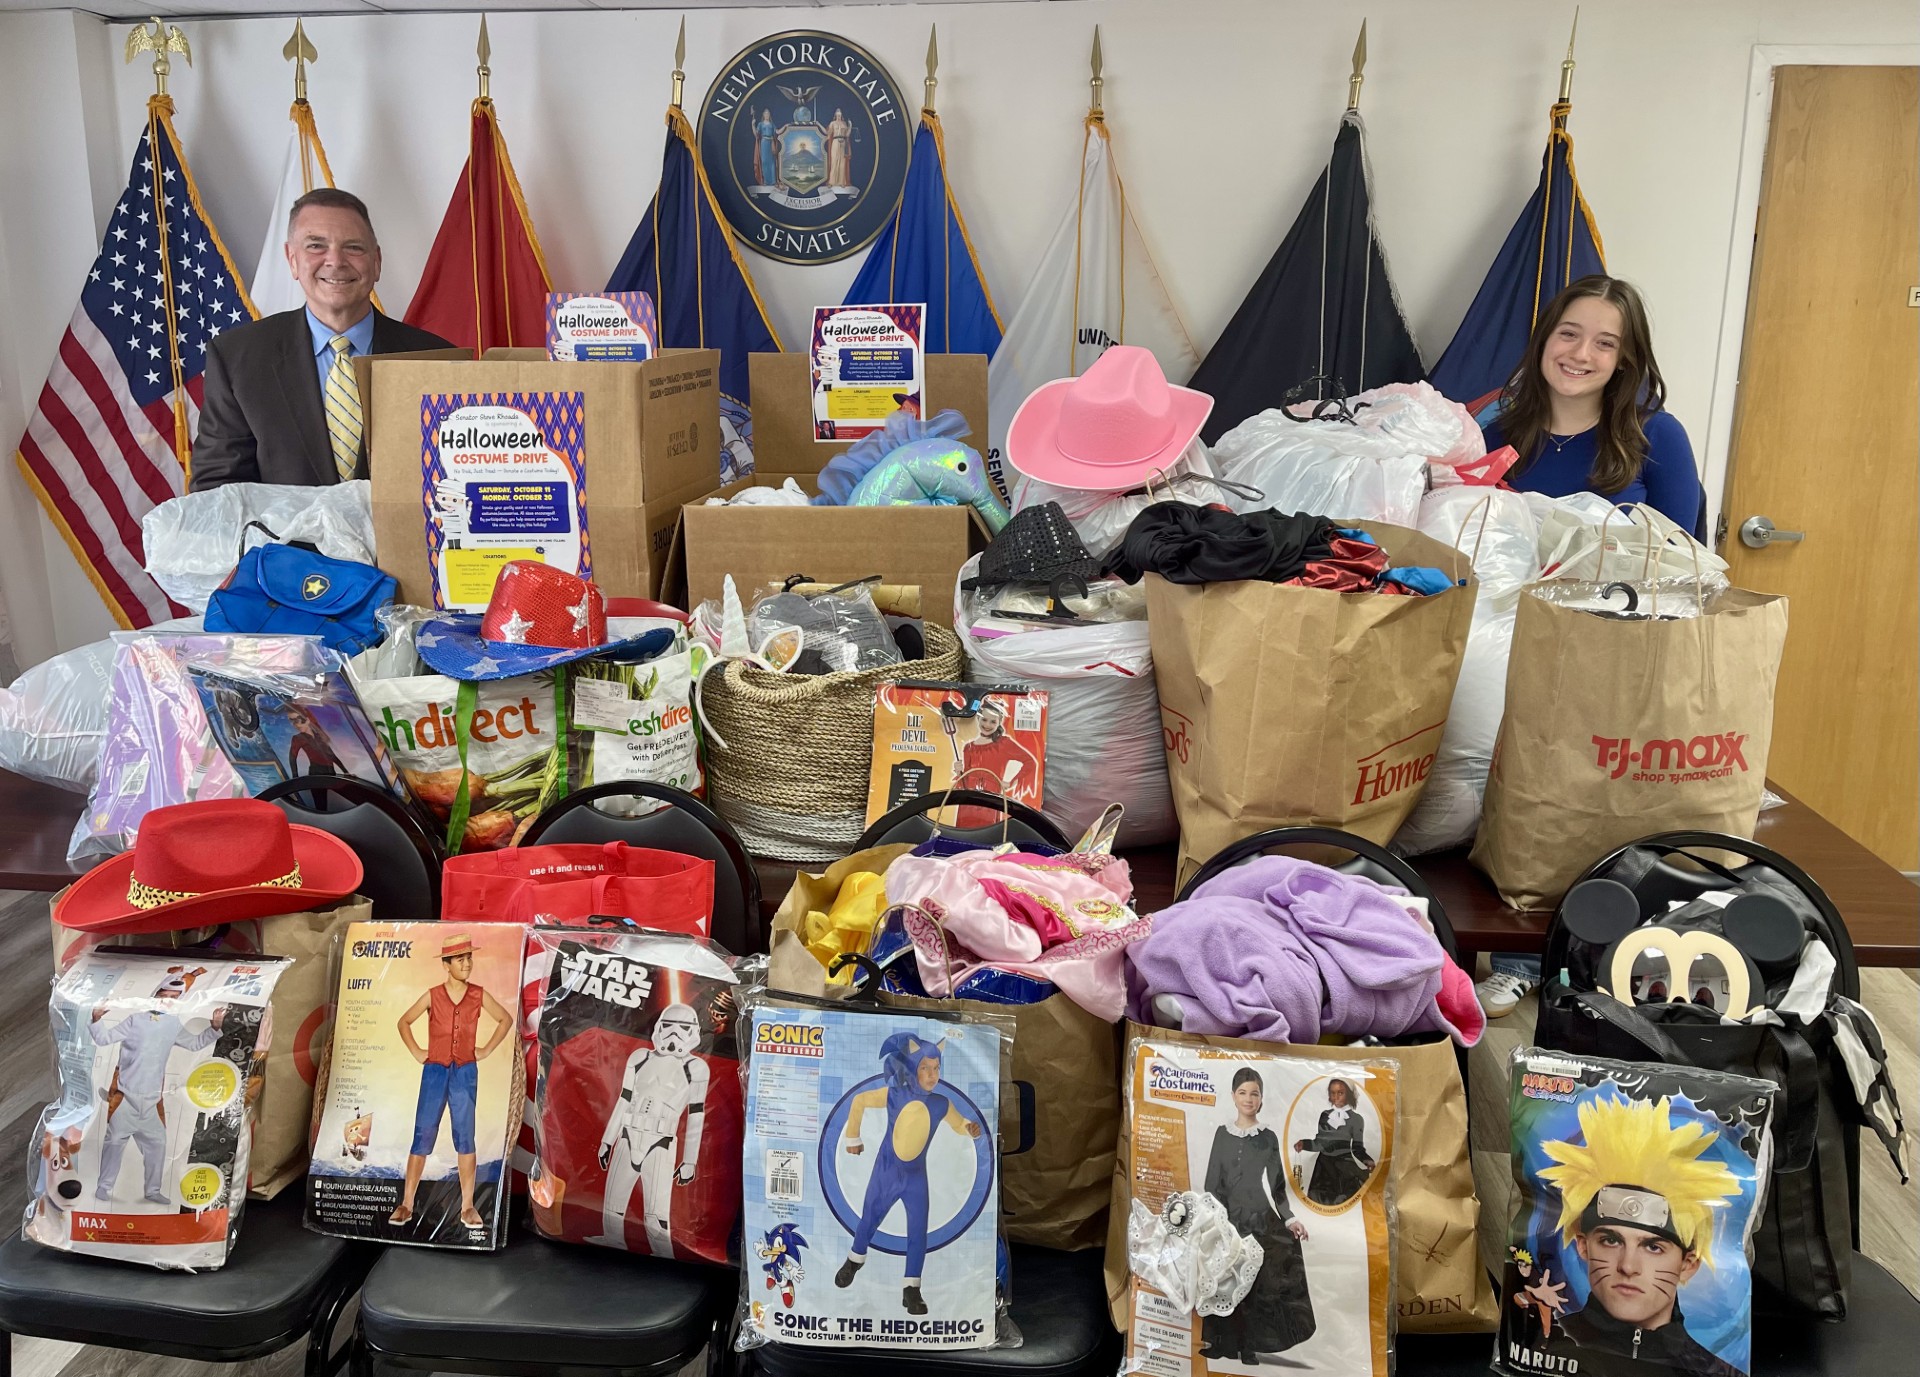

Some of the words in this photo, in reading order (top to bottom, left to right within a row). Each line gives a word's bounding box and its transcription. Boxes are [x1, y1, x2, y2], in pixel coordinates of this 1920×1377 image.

[711, 61, 757, 122] NEW
[758, 42, 835, 70] YORK
[838, 55, 896, 126] STATE
[756, 223, 851, 254] SENATE
[559, 314, 628, 328] Halloween
[571, 329, 610, 337] COSTUME
[824, 324, 895, 336] Halloween
[836, 335, 876, 343] COSTUME
[441, 427, 543, 449] Halloween
[453, 453, 509, 465] COSTUME
[514, 452, 549, 463] DRIVE
[478, 486, 512, 494] SATURDAY,
[902, 730, 928, 743] DEVIL
[627, 743, 642, 751] Get
[1350, 753, 1434, 806] Home
[1632, 771, 1665, 783] shop
[530, 866, 546, 876] use
[547, 865, 555, 873] it
[556, 863, 573, 873] and
[598, 863, 605, 871] it
[382, 941, 414, 958] PIECE
[562, 950, 652, 990] STAR
[347, 978, 372, 990] LUFFY
[561, 967, 650, 1009] WARS
[757, 1022, 824, 1047] SONIC
[756, 1044, 772, 1052] THE
[776, 1045, 823, 1056] HEDGEHOG
[1159, 1077, 1215, 1093] Costumes
[1522, 1073, 1575, 1094] NARUTO
[193, 1185, 207, 1193] L/G
[322, 1182, 397, 1193] YOUTH/JEUNESSE/JUVENIL
[186, 1193, 211, 1201] (5T-6T)
[321, 1202, 379, 1211] LARGE/GRAND/GRANDE
[78, 1217, 107, 1230] MAX
[1153, 1297, 1178, 1311] WARNIN
[1141, 1305, 1156, 1313] CHOKING
[1156, 1309, 1170, 1317] HAZARD
[774, 1312, 828, 1331] SONIC
[837, 1317, 873, 1333] THE
[880, 1318, 984, 1335] HEDGEHOG
[780, 1329, 803, 1338] CHILD
[806, 1332, 846, 1341] COSTUME
[942, 1335, 977, 1343] ENFANT
[1150, 1327, 1162, 1335] MISE
[1168, 1332, 1185, 1340] GARDE
[1150, 1355, 1181, 1367] ADVERTENCIA
[1509, 1341, 1579, 1374] NARUTO
